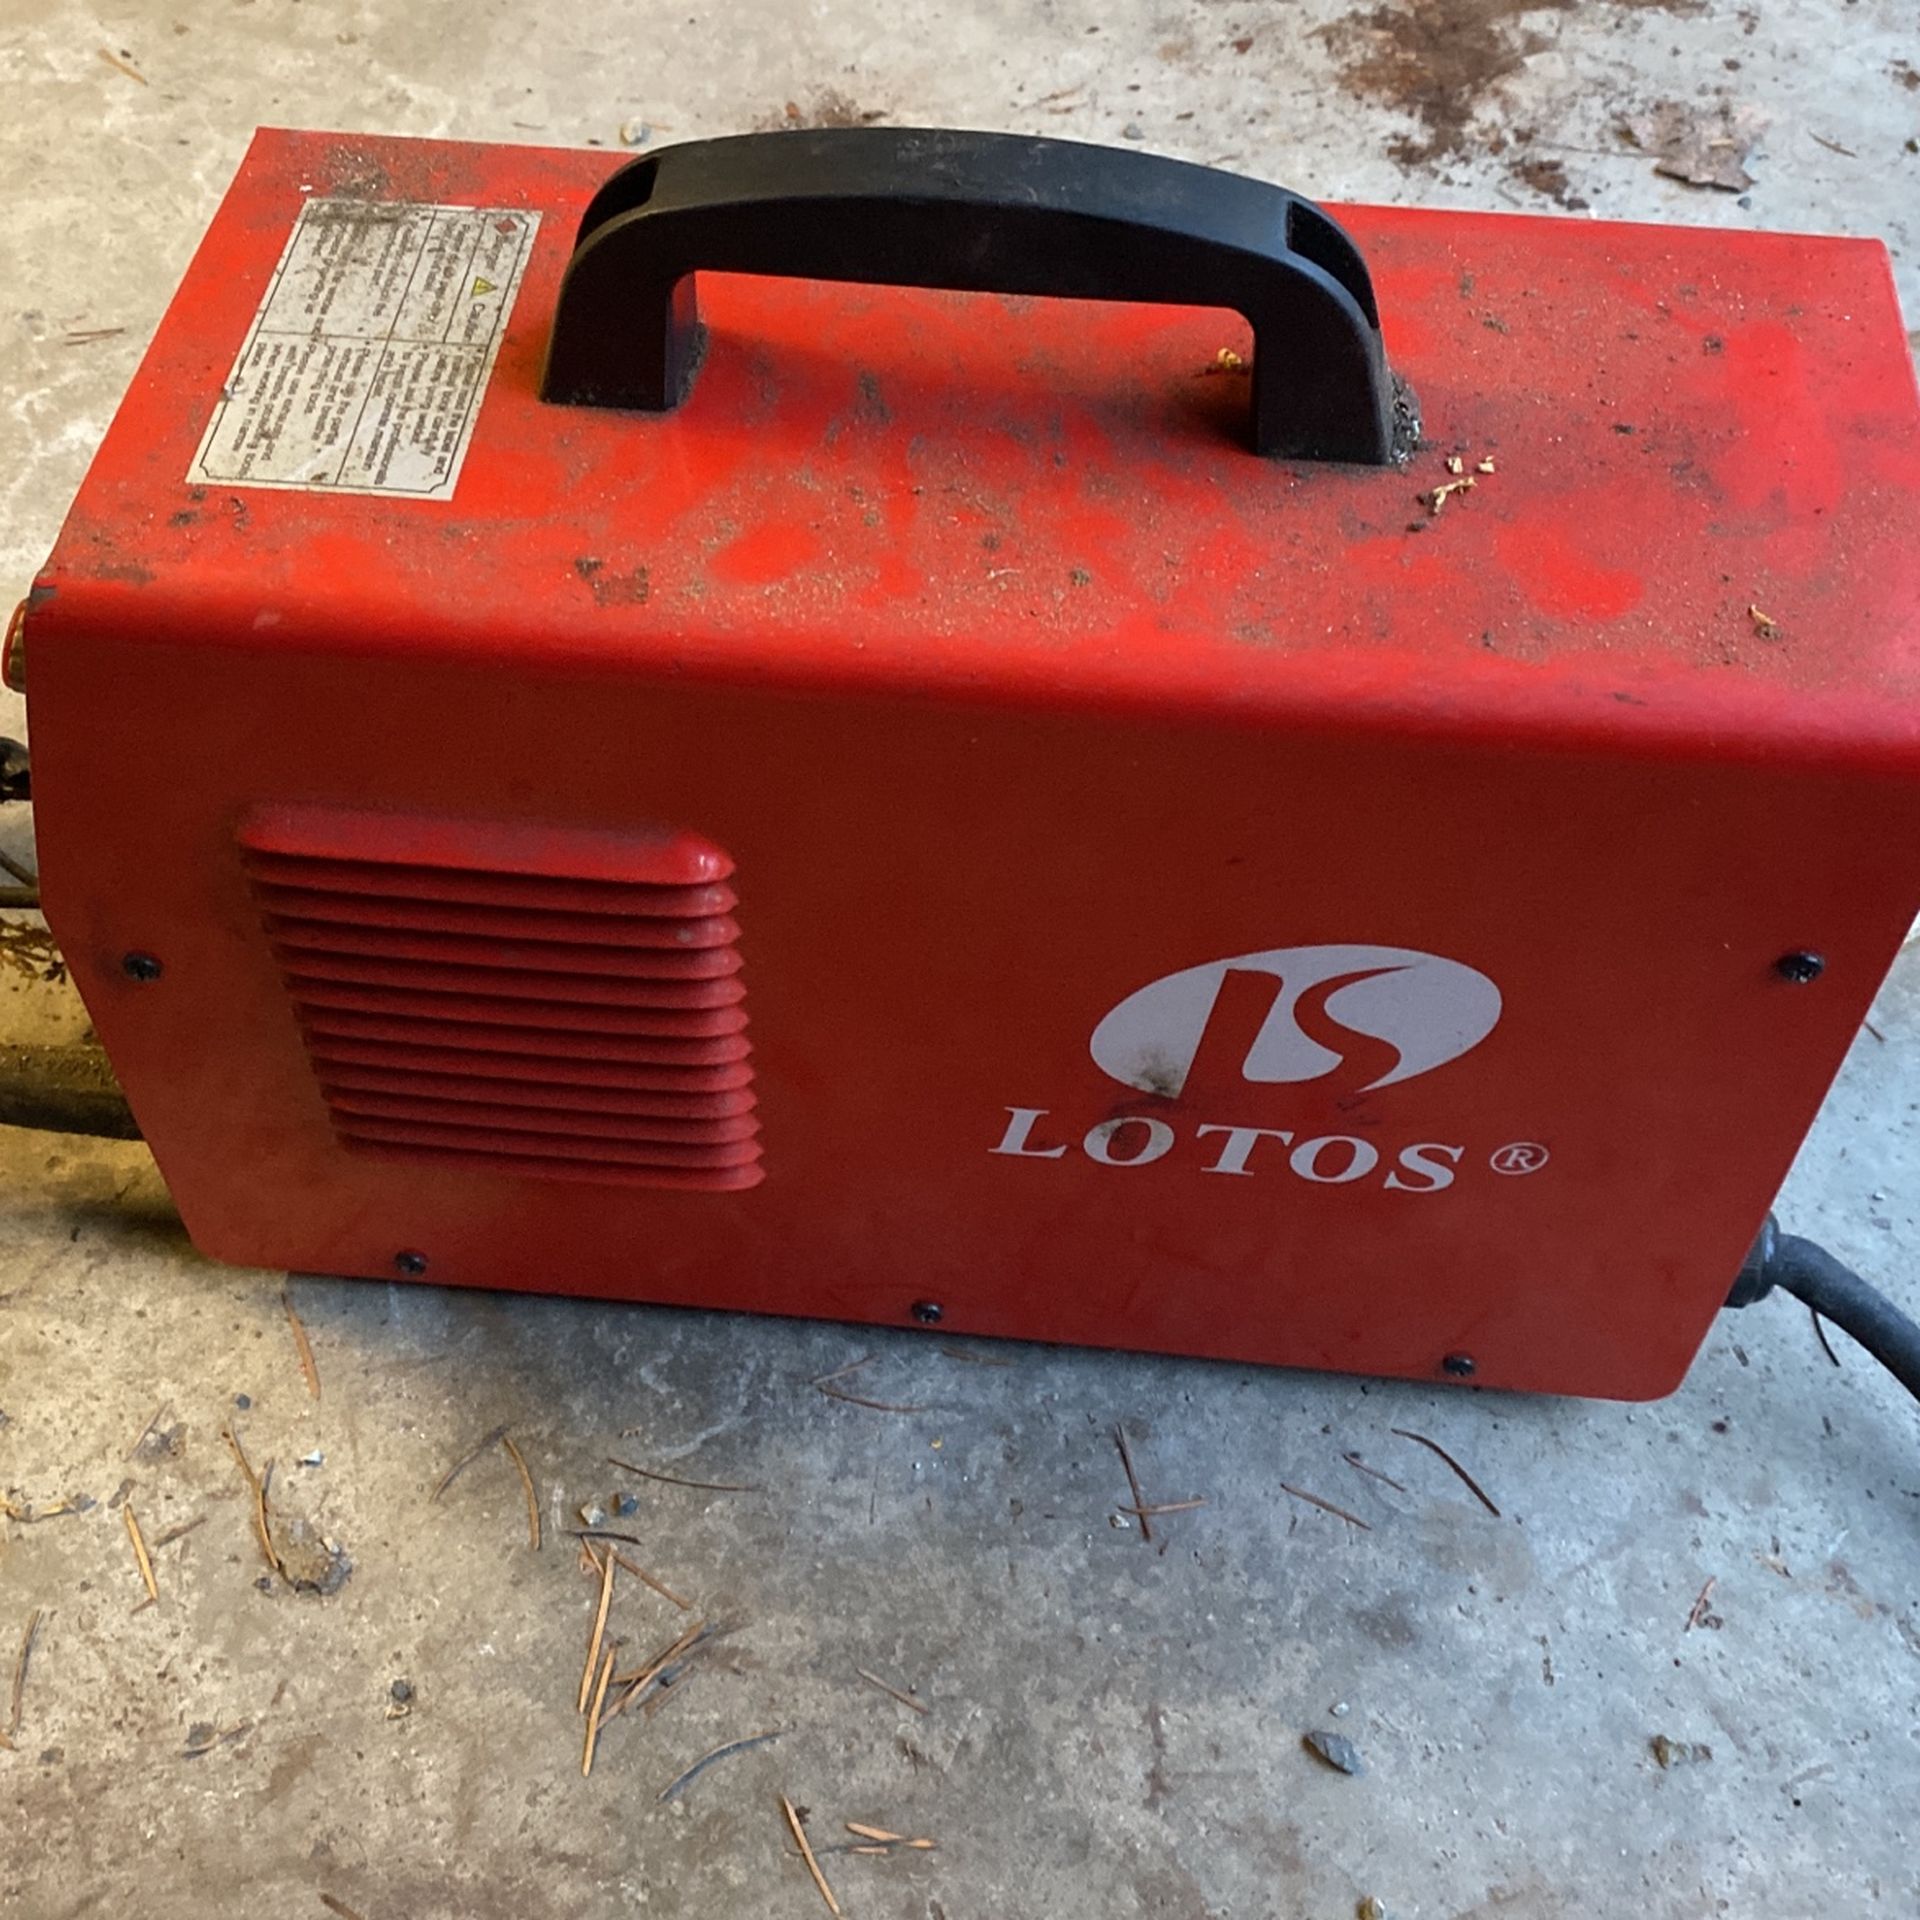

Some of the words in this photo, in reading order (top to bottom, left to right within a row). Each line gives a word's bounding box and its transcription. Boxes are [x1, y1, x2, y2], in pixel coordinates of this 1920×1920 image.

[460, 302, 486, 344] Caution
[247, 370, 272, 405] working
[286, 378, 301, 395] use
[324, 384, 340, 402] and
[245, 407, 257, 416] in
[335, 400, 351, 415] the
[447, 412, 463, 428] the
[439, 429, 457, 453] label
[432, 455, 448, 474] and
[988, 1106, 1465, 1192] LOTOS
